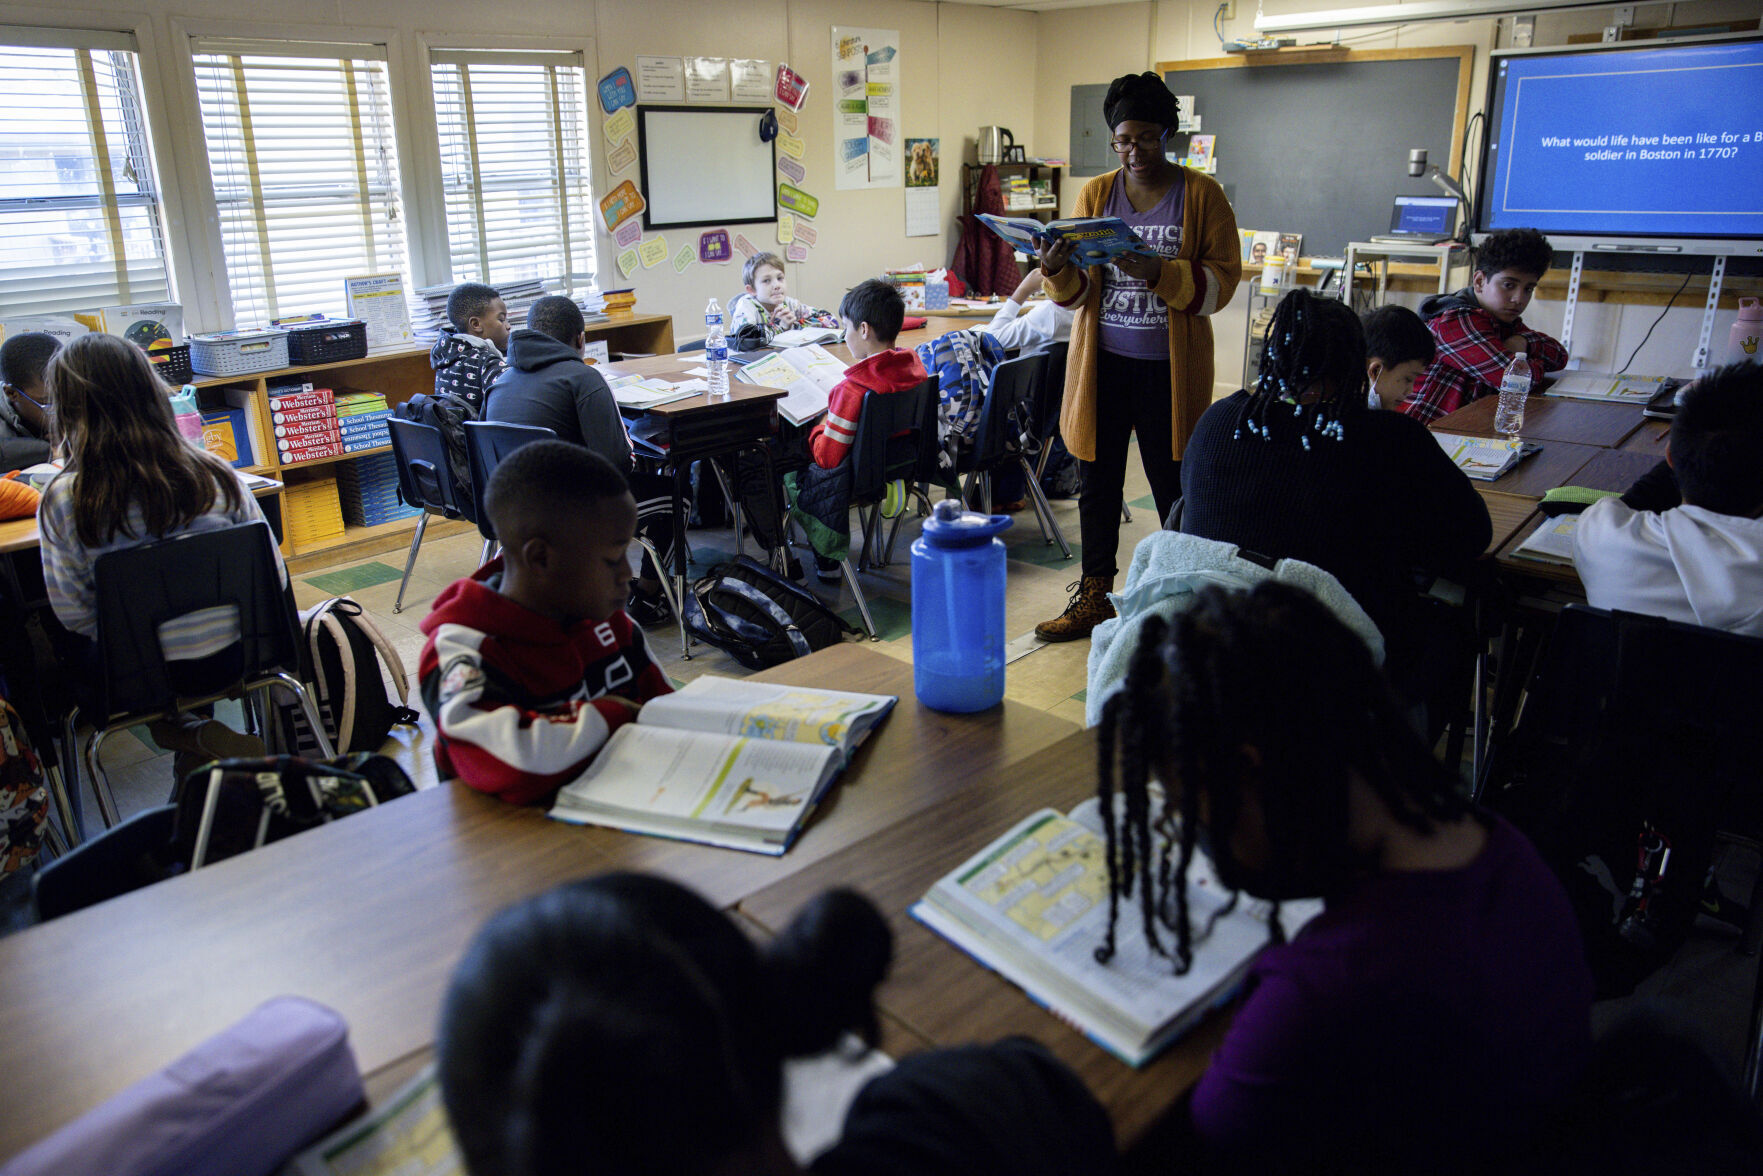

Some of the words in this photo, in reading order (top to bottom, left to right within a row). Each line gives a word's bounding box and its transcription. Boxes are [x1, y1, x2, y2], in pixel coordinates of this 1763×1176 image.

[1542, 136, 1570, 147] What
[1574, 135, 1608, 146] would
[1611, 134, 1629, 146] life
[1632, 134, 1659, 146] have
[1662, 133, 1692, 145] been
[1696, 133, 1717, 144] like
[1721, 132, 1739, 143] for
[1743, 134, 1750, 143] a
[1584, 150, 1623, 161] soldier
[1626, 149, 1636, 160] in
[1640, 149, 1681, 160] Boston
[1684, 149, 1696, 159] in
[1699, 147, 1738, 159] 1770?
[1130, 225, 1183, 242] STIC
[1102, 288, 1168, 313] USTIC
[282, 397, 322, 409] Webster's
[285, 410, 326, 422] Webster's
[365, 413, 392, 422] Thesaurus
[286, 423, 327, 436] Webster's
[290, 436, 330, 449] Webster's
[354, 442, 370, 450] School
[293, 449, 333, 462] Webster's
[594, 622, 616, 647] 6
